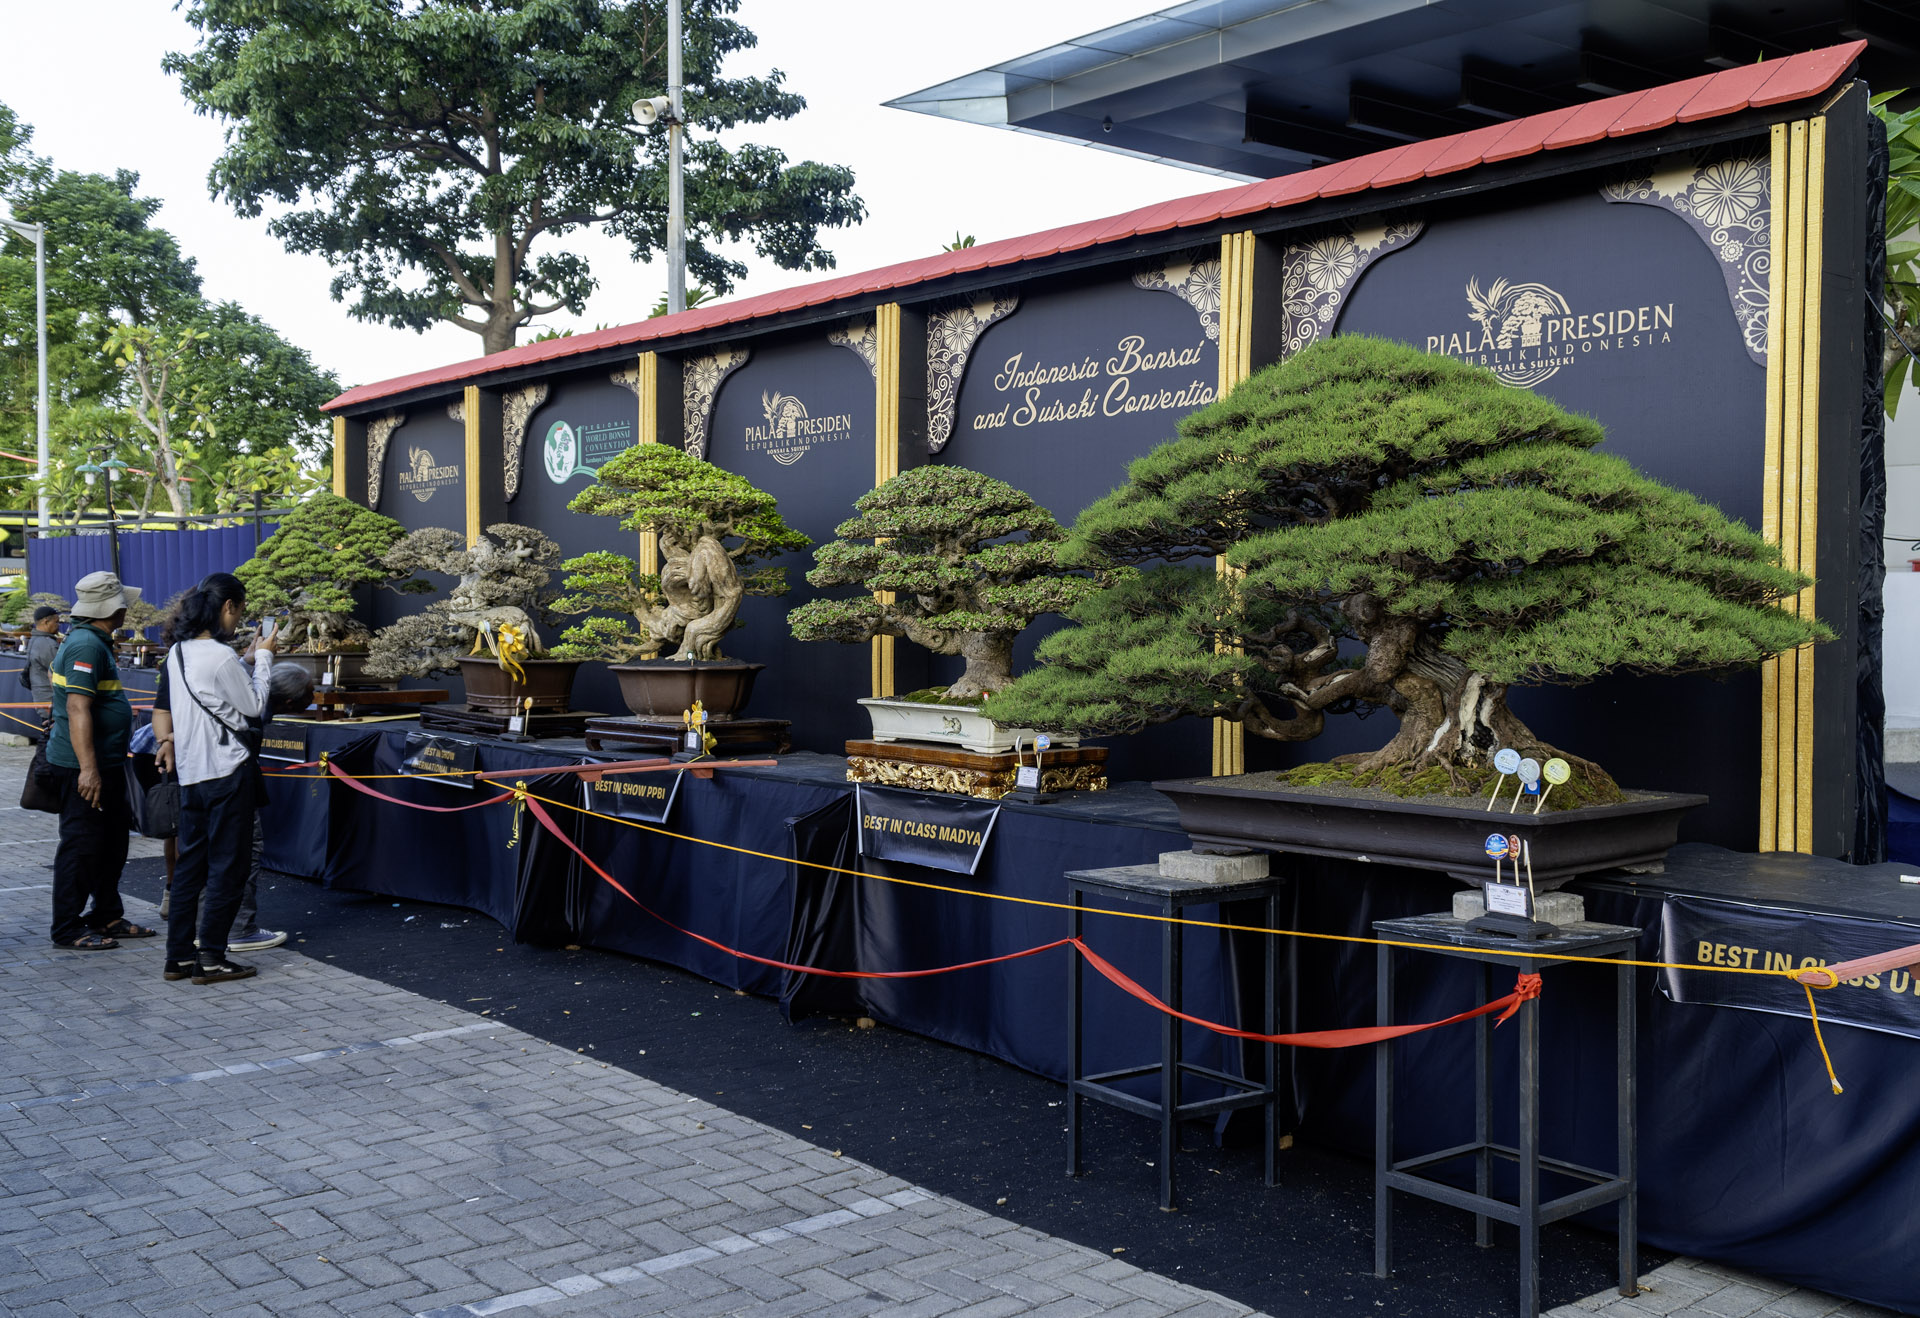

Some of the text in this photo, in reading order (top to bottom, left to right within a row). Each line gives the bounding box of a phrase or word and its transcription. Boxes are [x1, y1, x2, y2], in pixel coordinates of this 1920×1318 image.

[1427, 303, 1674, 356] PIALA PRESIDEN
[1537, 332, 1671, 358] INDONESIA
[994, 335, 1205, 391] Indonesia Bonsai
[1531, 356, 1575, 369] SUISEKI
[973, 403, 1010, 430] and
[1012, 387, 1099, 426] Suiseki
[585, 420, 630, 430] REGIONAL
[745, 413, 851, 442] PIALA PRESIDEN
[585, 430, 630, 443] WORLD BONSAI
[585, 440, 630, 451] CONVENTION
[745, 432, 850, 451] REPUBLIK INDONESIA
[400, 465, 458, 483] PIALA PRESIDEN
[595, 781, 665, 799] BEST IN SHOW PPBI
[863, 814, 980, 846] BEST IN CLASS MADYA
[1697, 941, 1759, 969] BEST
[1764, 951, 1793, 971] IN
